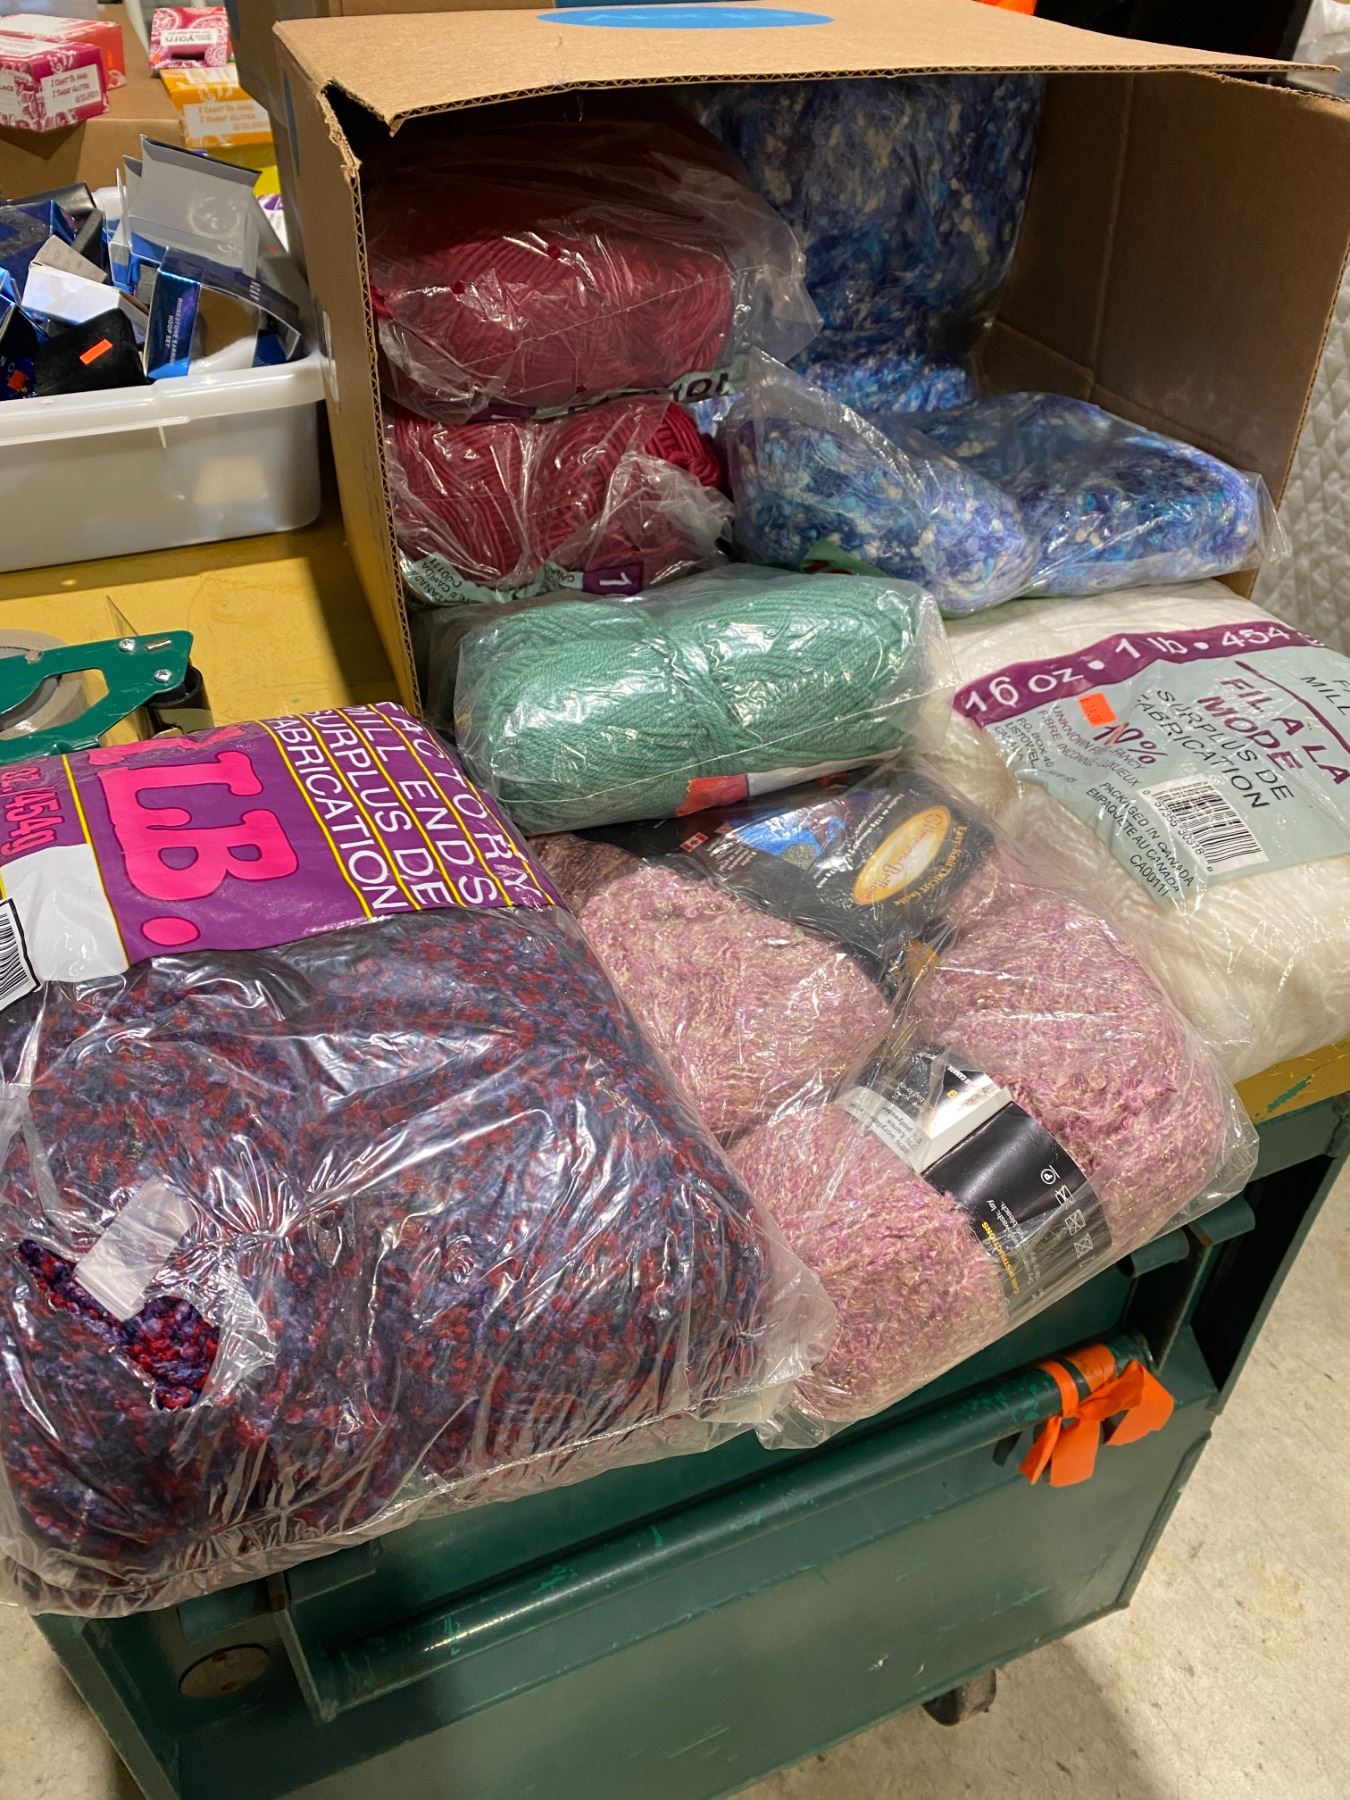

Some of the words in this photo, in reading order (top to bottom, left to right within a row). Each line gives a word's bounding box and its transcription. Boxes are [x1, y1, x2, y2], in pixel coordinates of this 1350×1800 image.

[964, 675, 1021, 713] 16
[1027, 667, 1085, 693] oz
[1114, 637, 1142, 660] 1
[1146, 636, 1189, 655] lb
[1221, 626, 1292, 648] 454
[1300, 676, 1350, 717] MILL
[1030, 730, 1046, 756] BOX
[1156, 689, 1259, 763] SURPLUS
[1254, 768, 1296, 801] DE
[1197, 696, 1304, 771] MODE
[1219, 677, 1273, 713] FIL
[1270, 716, 1306, 737] A
[1301, 744, 1350, 785] LA
[267, 714, 410, 910] ABRICATION
[341, 706, 407, 762] MILL
[398, 780, 498, 905] ENDS
[375, 701, 543, 898] FACTORY
[1145, 826, 1161, 841] IN
[393, 848, 454, 905] DE
[1132, 835, 1151, 850] AU
